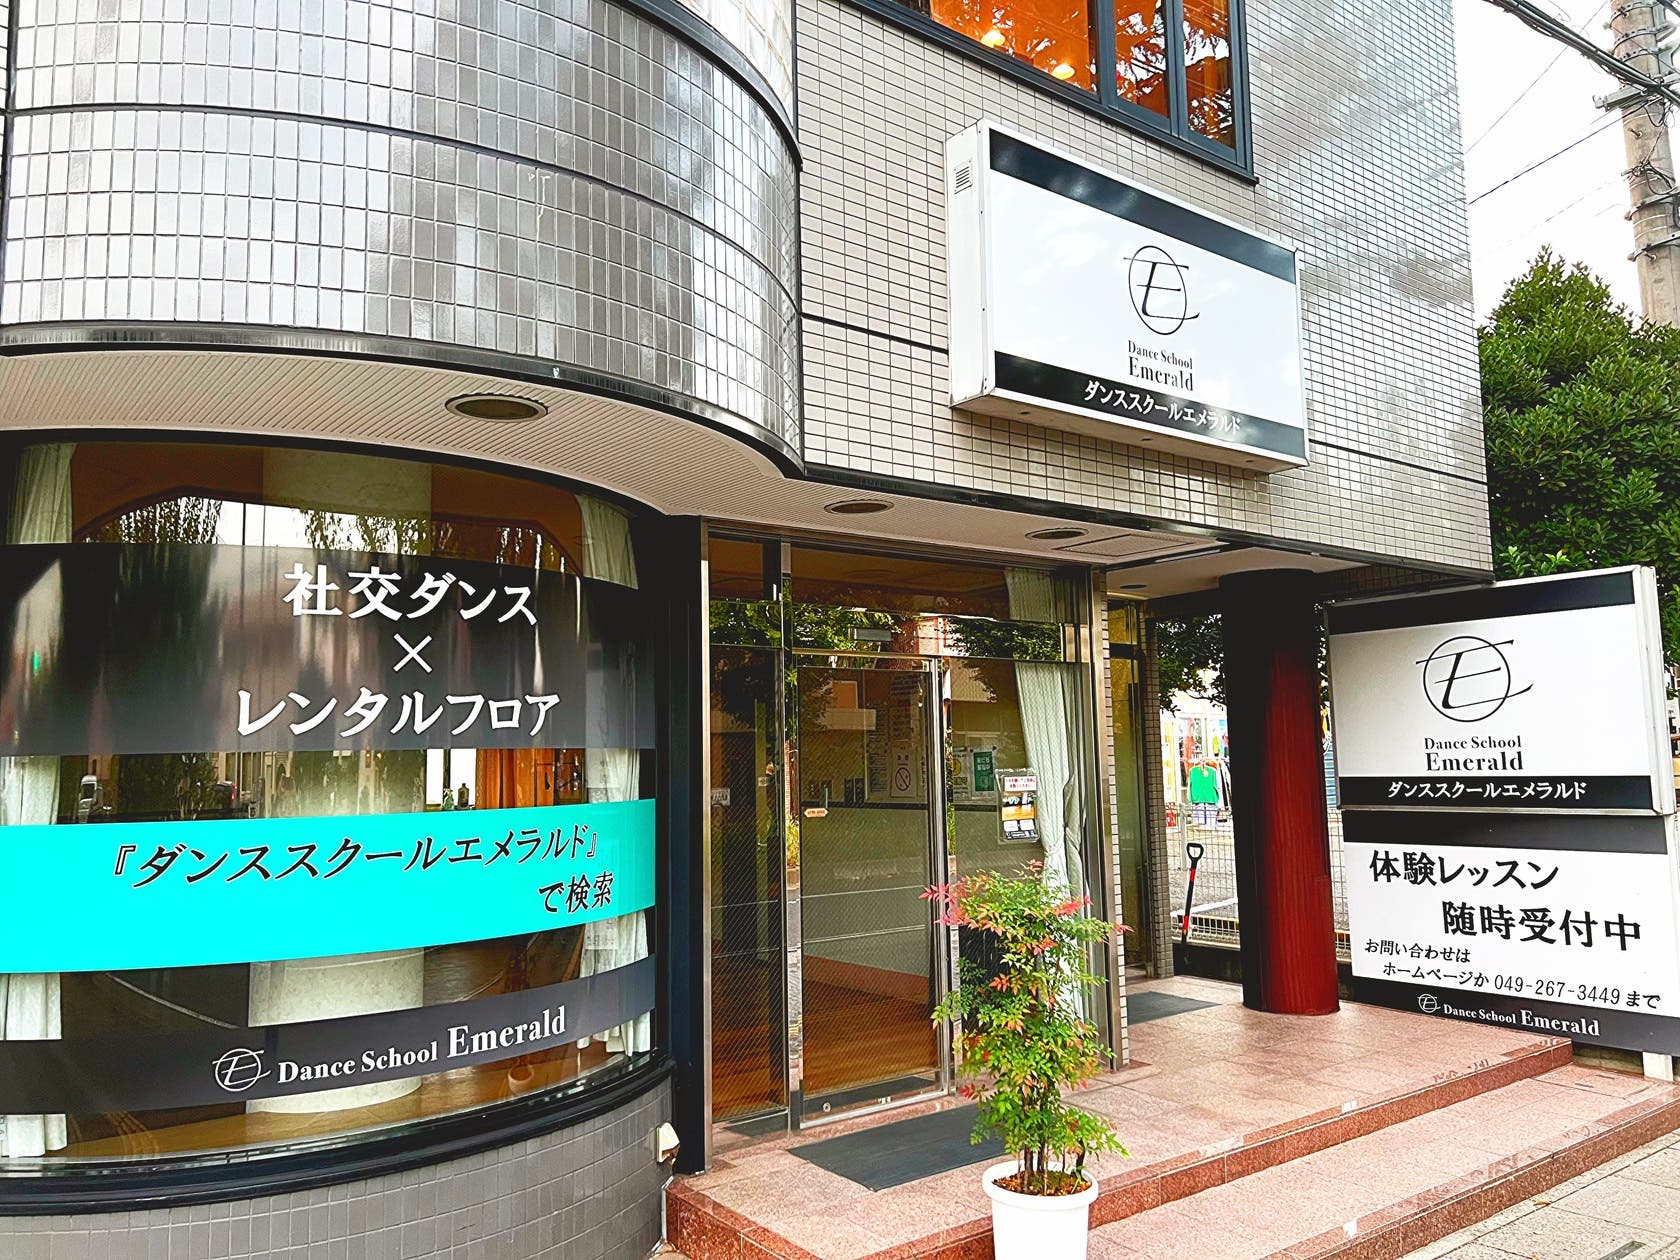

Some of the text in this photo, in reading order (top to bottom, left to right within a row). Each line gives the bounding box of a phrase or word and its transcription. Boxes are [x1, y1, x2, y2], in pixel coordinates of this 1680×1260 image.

[1128, 340, 1193, 370] Dance School
[1128, 356, 1194, 391] Emerald
[1083, 379, 1242, 435] ダンススクールエメラルド
[282, 562, 539, 626] 社交ダンス
[237, 687, 560, 737] レンタルフロア
[1424, 736, 1522, 750] Dance School
[1425, 750, 1524, 771] Emerald
[1387, 781, 1587, 800] ダンススクールエメラルド
[114, 823, 599, 888] 『ダンススクールエメラルド』
[1370, 849, 1559, 890] 体験レッスン
[538, 871, 614, 914] で検索
[1441, 901, 1641, 952] 随時受付中
[1365, 939, 1471, 964] お問い合わせは
[1383, 962, 1662, 1010] ホームページか 049-267-3449 まで
[1443, 1004, 1477, 1018] Dance
[1478, 1008, 1517, 1025] School
[1519, 1008, 1601, 1037] Emerald
[277, 1058, 356, 1084] Dance
[361, 1041, 438, 1073] School
[447, 1005, 566, 1059] Emerald
